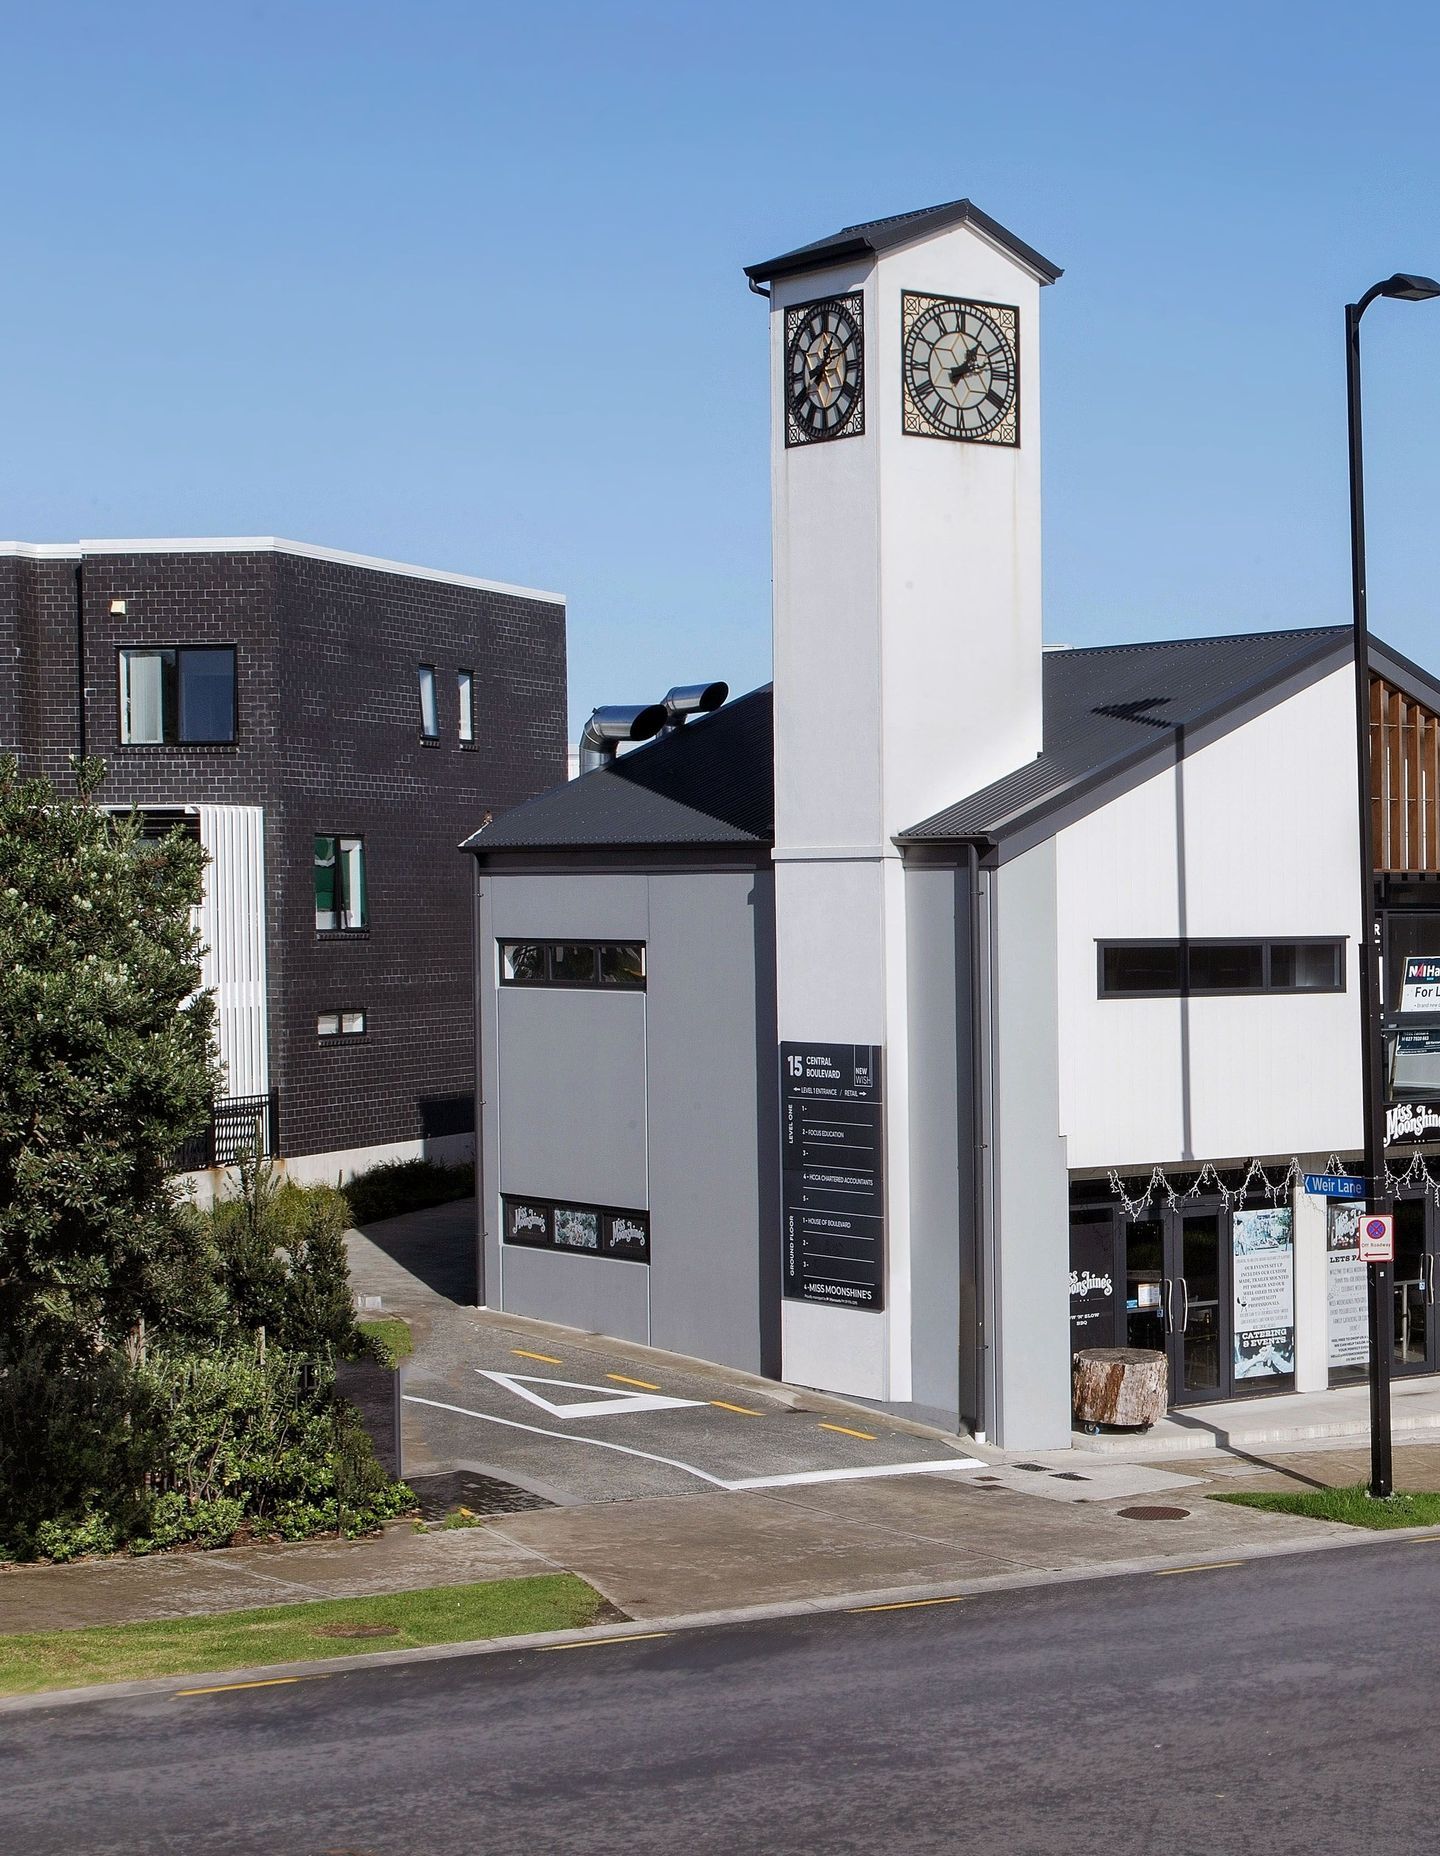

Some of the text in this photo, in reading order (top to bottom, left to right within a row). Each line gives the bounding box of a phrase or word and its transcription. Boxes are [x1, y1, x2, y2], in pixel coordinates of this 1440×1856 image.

[1415, 986, 1433, 998] For
[788, 1055, 803, 1077] 15
[806, 1056, 832, 1066] CENTRAL
[806, 1068, 841, 1079] BOULEVARD
[855, 1067, 868, 1075] NEW
[816, 1088, 837, 1096] ENTRANCE
[844, 1089, 858, 1097] RETAIL
[1386, 1103, 1413, 1124] Miss
[808, 1129, 845, 1138] FOCUS EDUCATION
[821, 1175, 844, 1184] CHARTERED
[844, 1177, 873, 1186] ACCOUNTANTS
[1312, 1176, 1362, 1194] Weir Lane
[808, 1217, 821, 1226] HOUSE
[827, 1220, 851, 1229] BOULEVARD
[1330, 1255, 1351, 1263] LETS
[809, 1283, 872, 1300] MISS MOONSHINE'S
[1242, 1328, 1287, 1340] CATERING
[1250, 1336, 1287, 1347] EVENTS
